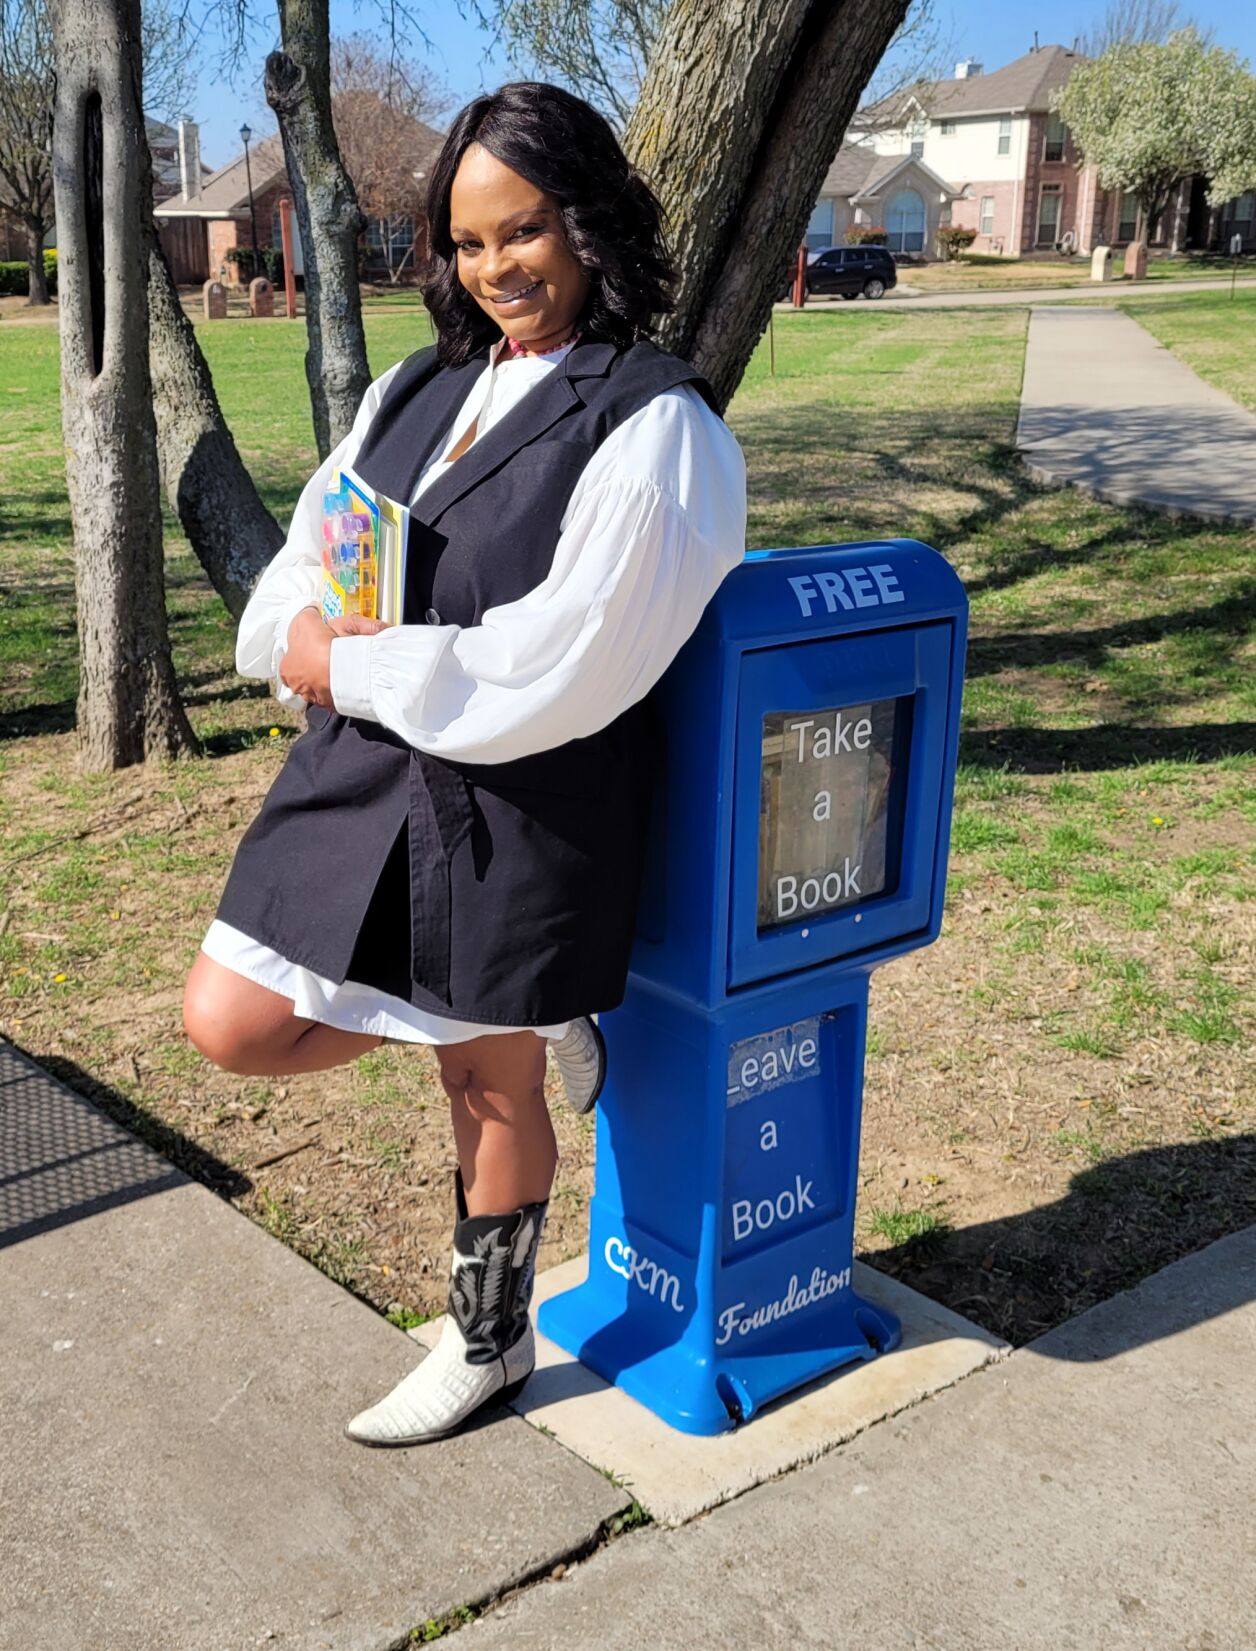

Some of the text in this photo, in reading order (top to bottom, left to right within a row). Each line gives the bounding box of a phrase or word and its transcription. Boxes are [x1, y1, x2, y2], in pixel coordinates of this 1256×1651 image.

[787, 564, 905, 617] FREE
[790, 713, 873, 763] Take
[812, 789, 831, 822] a
[777, 857, 862, 918] Book
[759, 1120, 778, 1151] a
[732, 1175, 815, 1241] Book
[715, 1266, 851, 1345] Foundation
